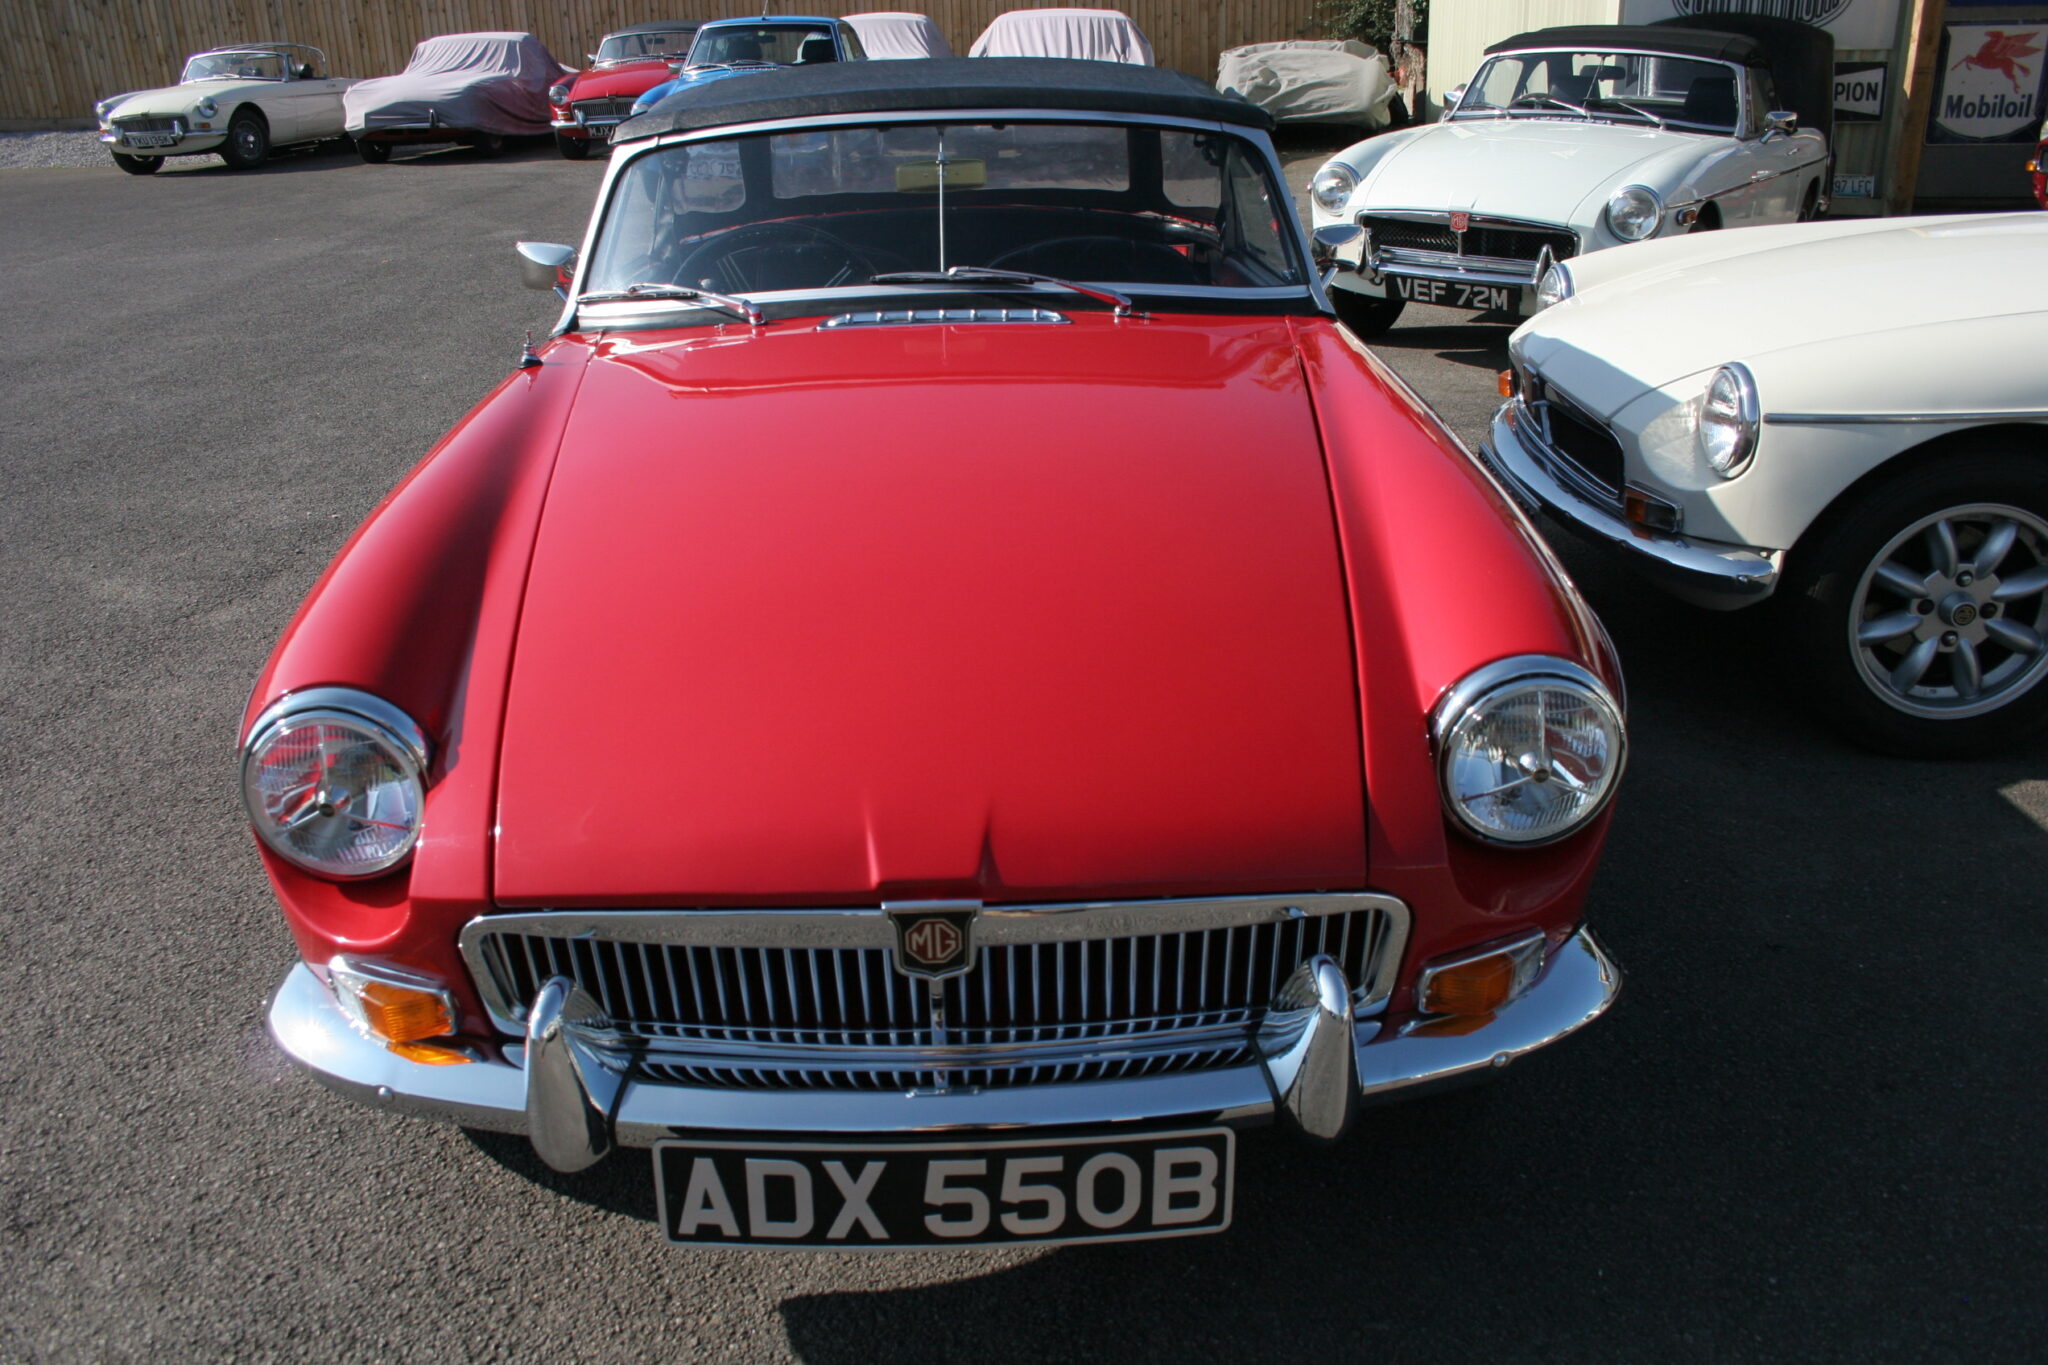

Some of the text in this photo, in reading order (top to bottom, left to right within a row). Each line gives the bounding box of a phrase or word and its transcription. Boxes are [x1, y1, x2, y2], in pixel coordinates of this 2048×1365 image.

[1944, 94, 2033, 118] Mobiloil
[1396, 277, 1508, 311] VEF 72M
[911, 923, 957, 959] MG
[677, 1146, 1219, 1240] ADX 550B
